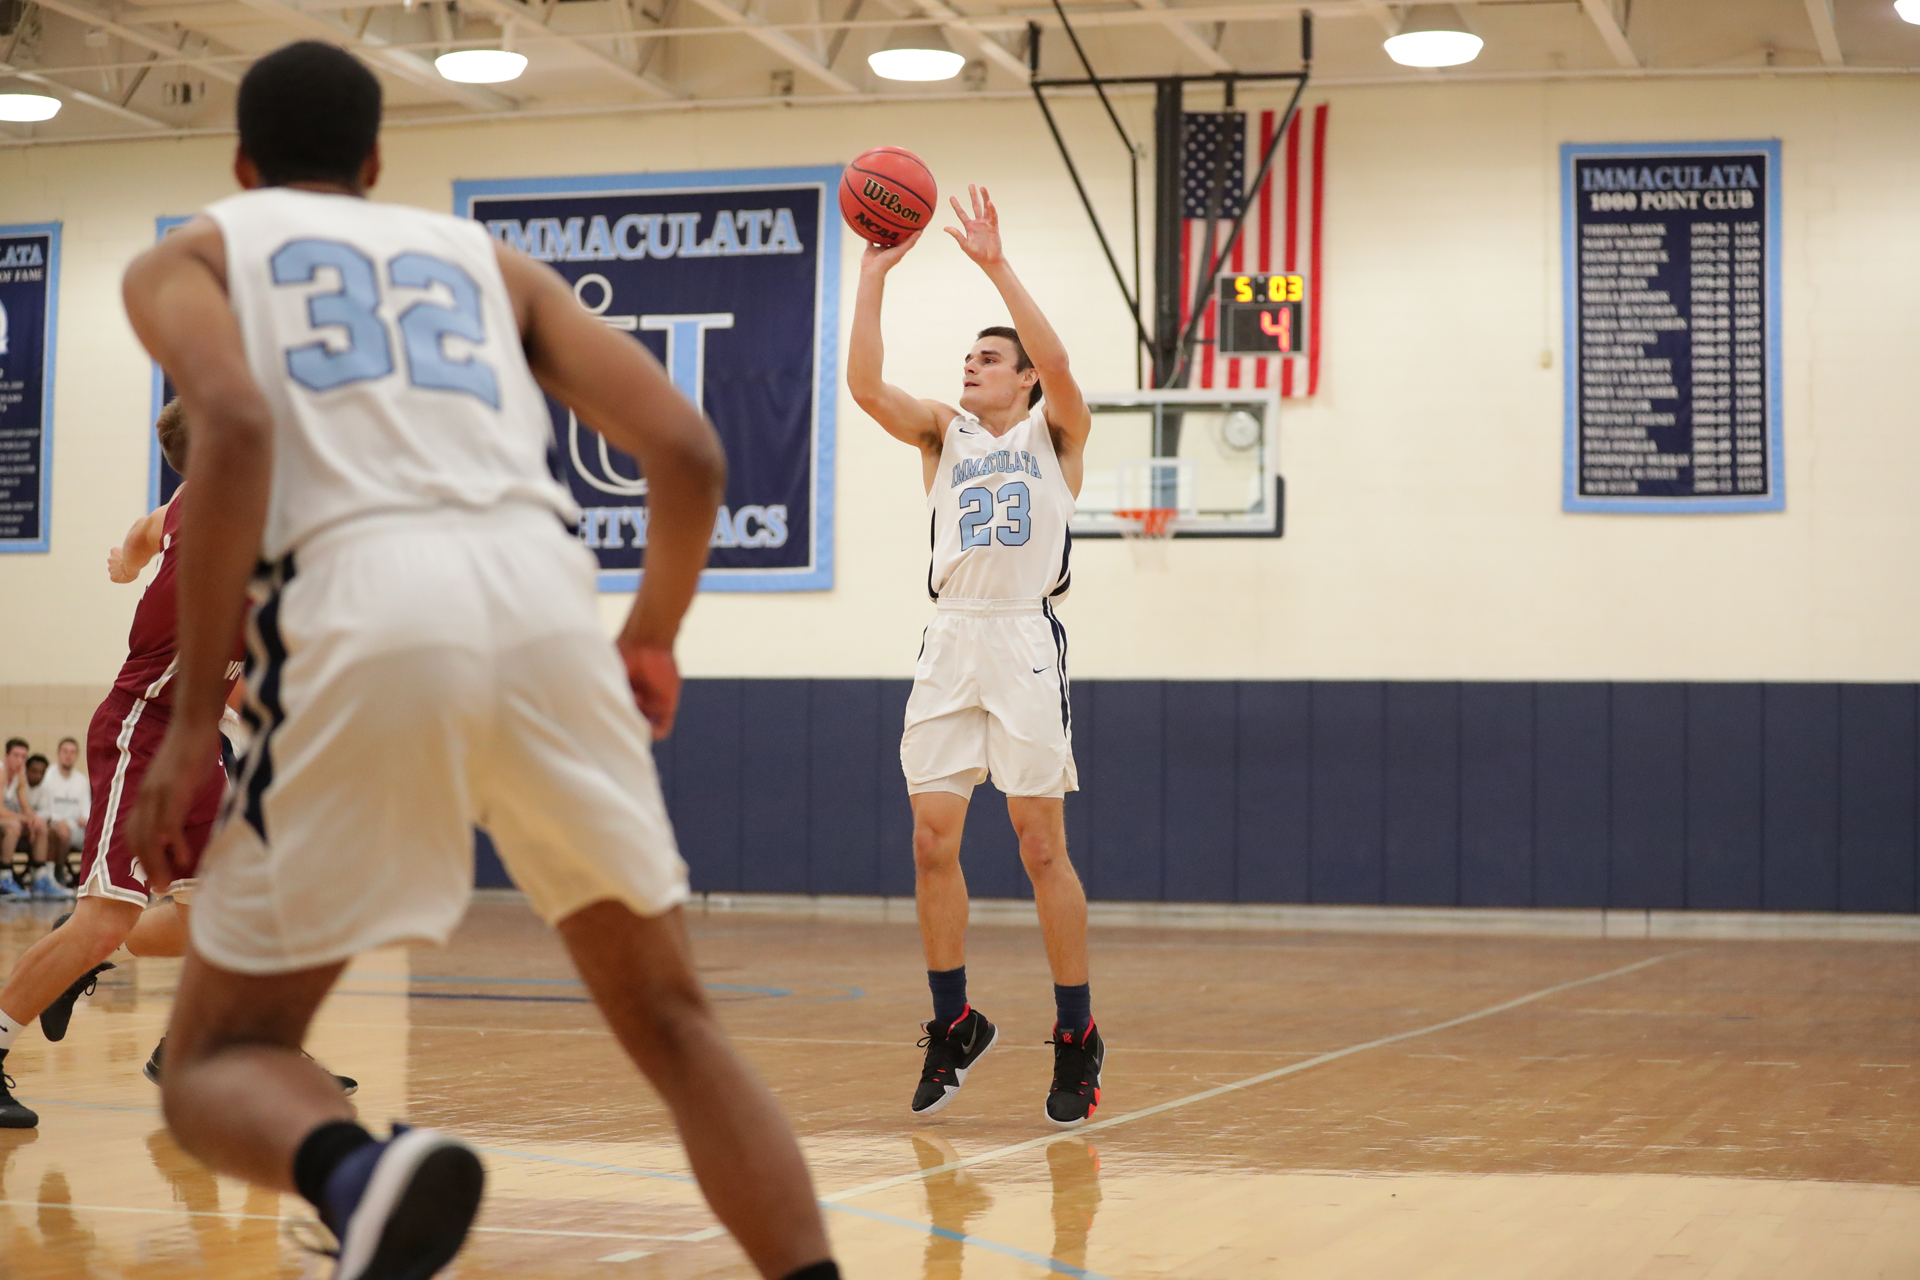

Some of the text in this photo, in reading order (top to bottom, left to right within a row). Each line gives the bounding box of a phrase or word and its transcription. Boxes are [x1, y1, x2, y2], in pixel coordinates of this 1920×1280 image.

[863, 177, 922, 223] Wilson
[1582, 165, 1759, 191] IMMACULATA
[1590, 189, 1754, 212] 1000 POINT CLUB
[485, 208, 803, 262] IMMACULATA
[855, 211, 902, 240] NCAA
[269, 238, 503, 411] 32
[1260, 307, 1290, 352] 4
[951, 450, 1042, 489] IMMACULATA
[578, 504, 788, 549] HTY ACS
[959, 481, 1031, 552] 23
